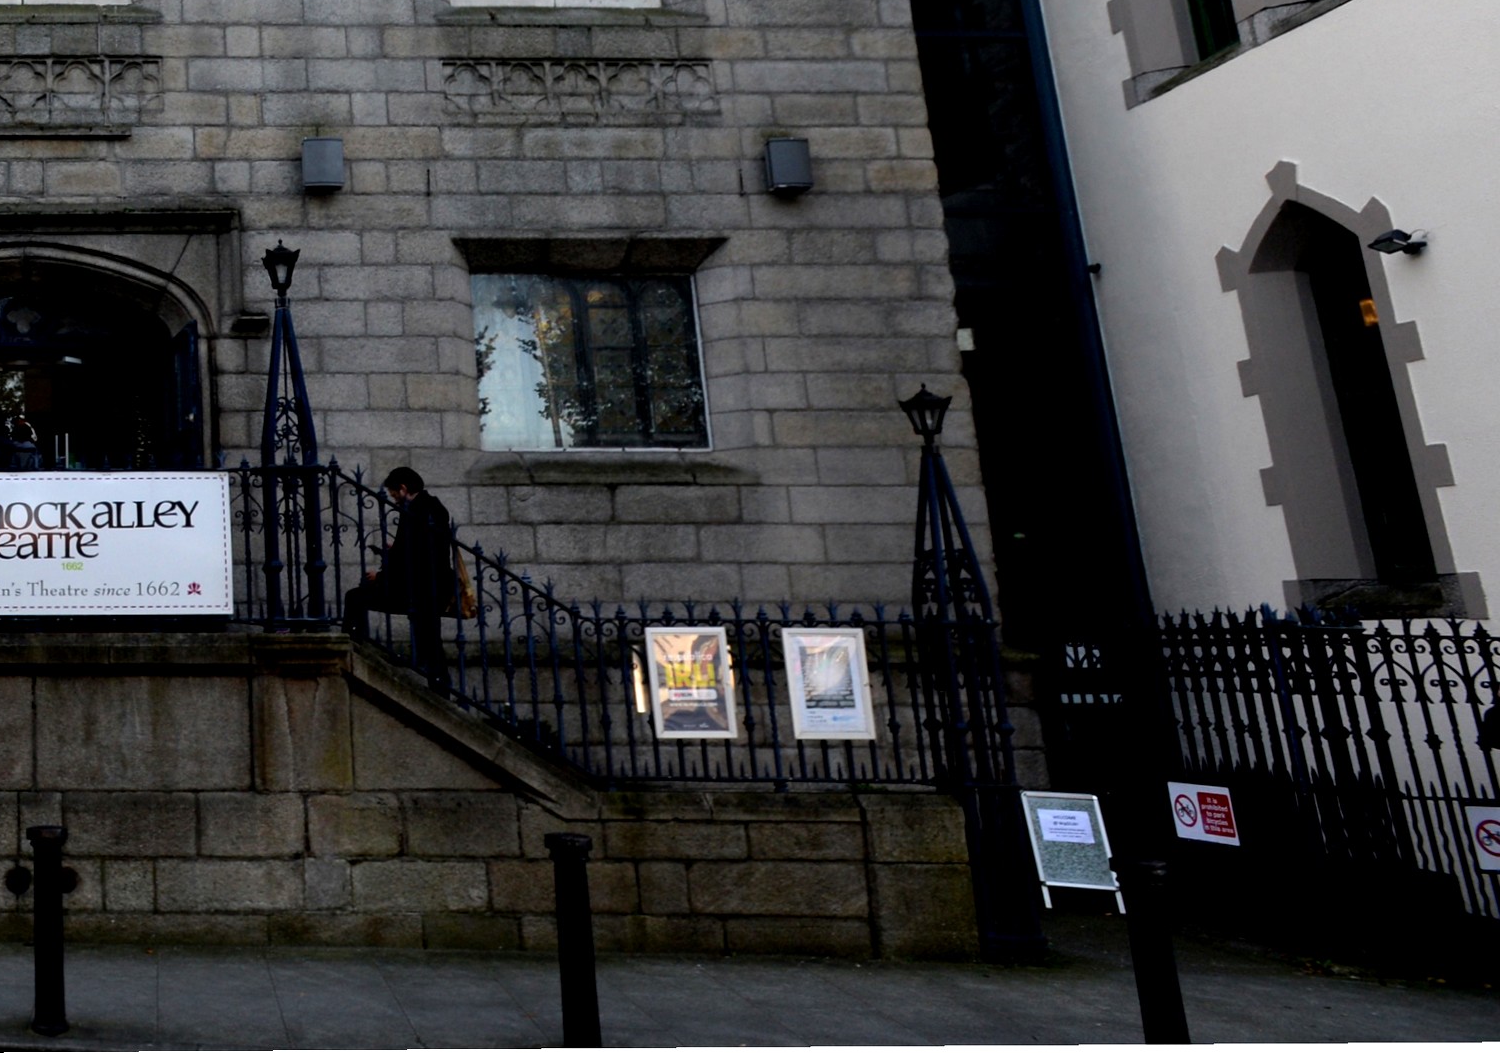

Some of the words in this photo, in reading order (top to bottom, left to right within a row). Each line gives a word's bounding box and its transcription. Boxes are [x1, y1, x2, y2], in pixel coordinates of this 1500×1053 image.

[61, 562, 84, 571] 1662
[27, 580, 88, 596] Theatre
[94, 583, 130, 596] since
[136, 581, 180, 596] 1662
[665, 662, 716, 688] IRL!
[1201, 804, 1228, 812] prohibited
[1206, 817, 1228, 827] bicycles
